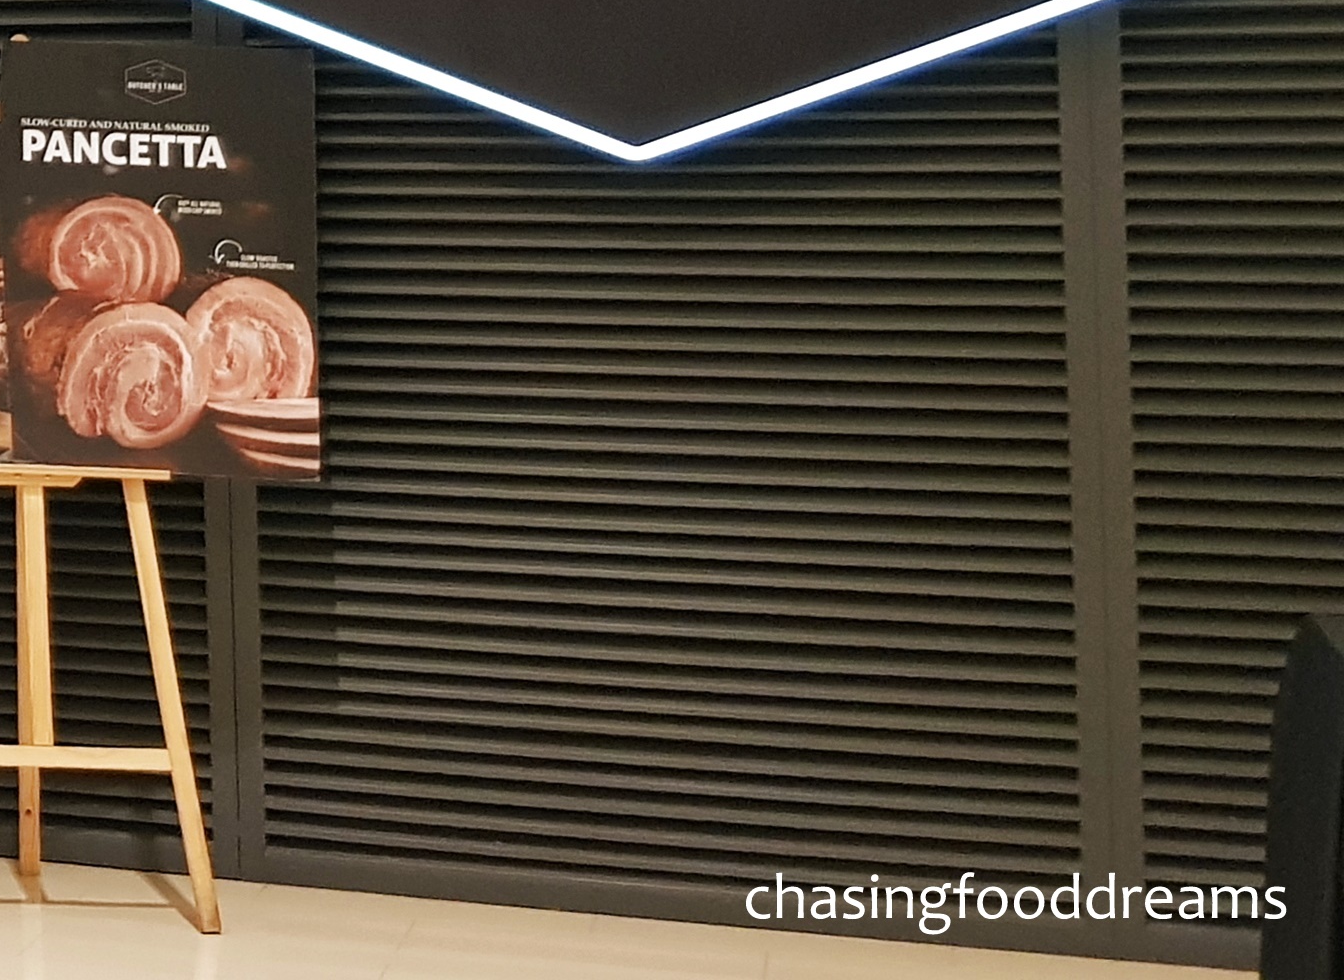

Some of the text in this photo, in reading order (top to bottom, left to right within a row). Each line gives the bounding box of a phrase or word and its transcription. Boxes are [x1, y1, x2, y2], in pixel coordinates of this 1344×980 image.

[20, 117, 210, 133] SLOW-CURED AND NATURAL SMOKED
[21, 128, 228, 169] PANCETTA
